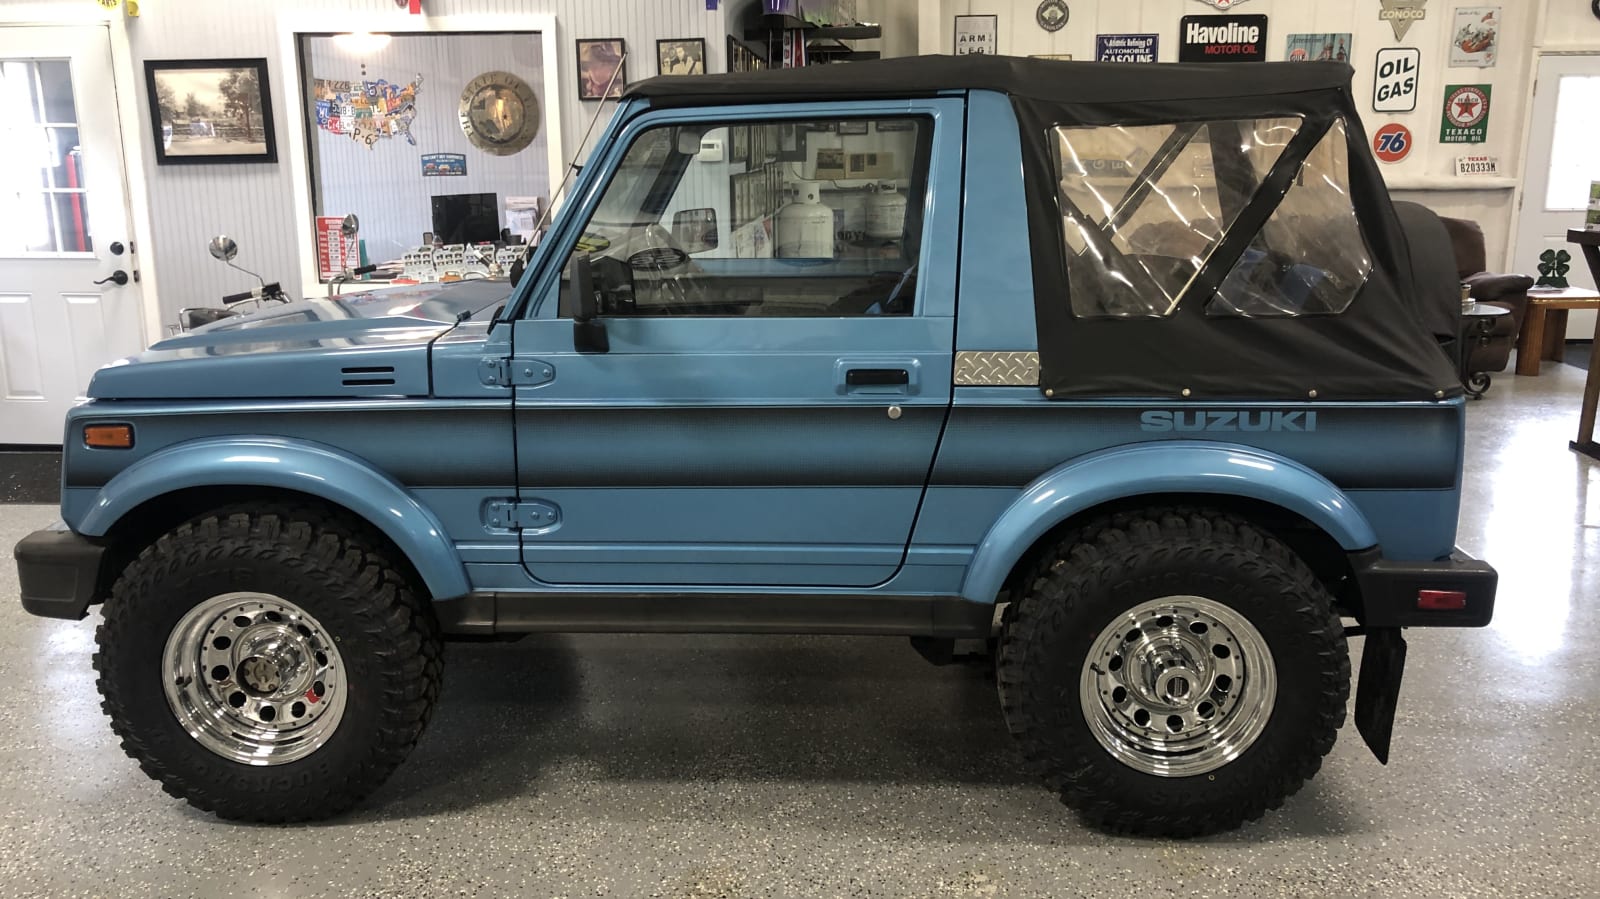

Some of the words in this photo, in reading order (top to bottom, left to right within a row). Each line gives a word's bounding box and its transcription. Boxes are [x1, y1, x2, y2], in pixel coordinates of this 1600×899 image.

[1380, 10, 1424, 19] CONOCO
[959, 34, 986, 42] ARM
[1186, 23, 1259, 44] Havoline
[1204, 44, 1240, 55] MOTOR
[1242, 44, 1257, 54] OIL
[1379, 57, 1415, 78] OIL
[1377, 77, 1414, 102] GAS
[1377, 132, 1407, 153] 76
[1140, 410, 1317, 432] SUZUKI
